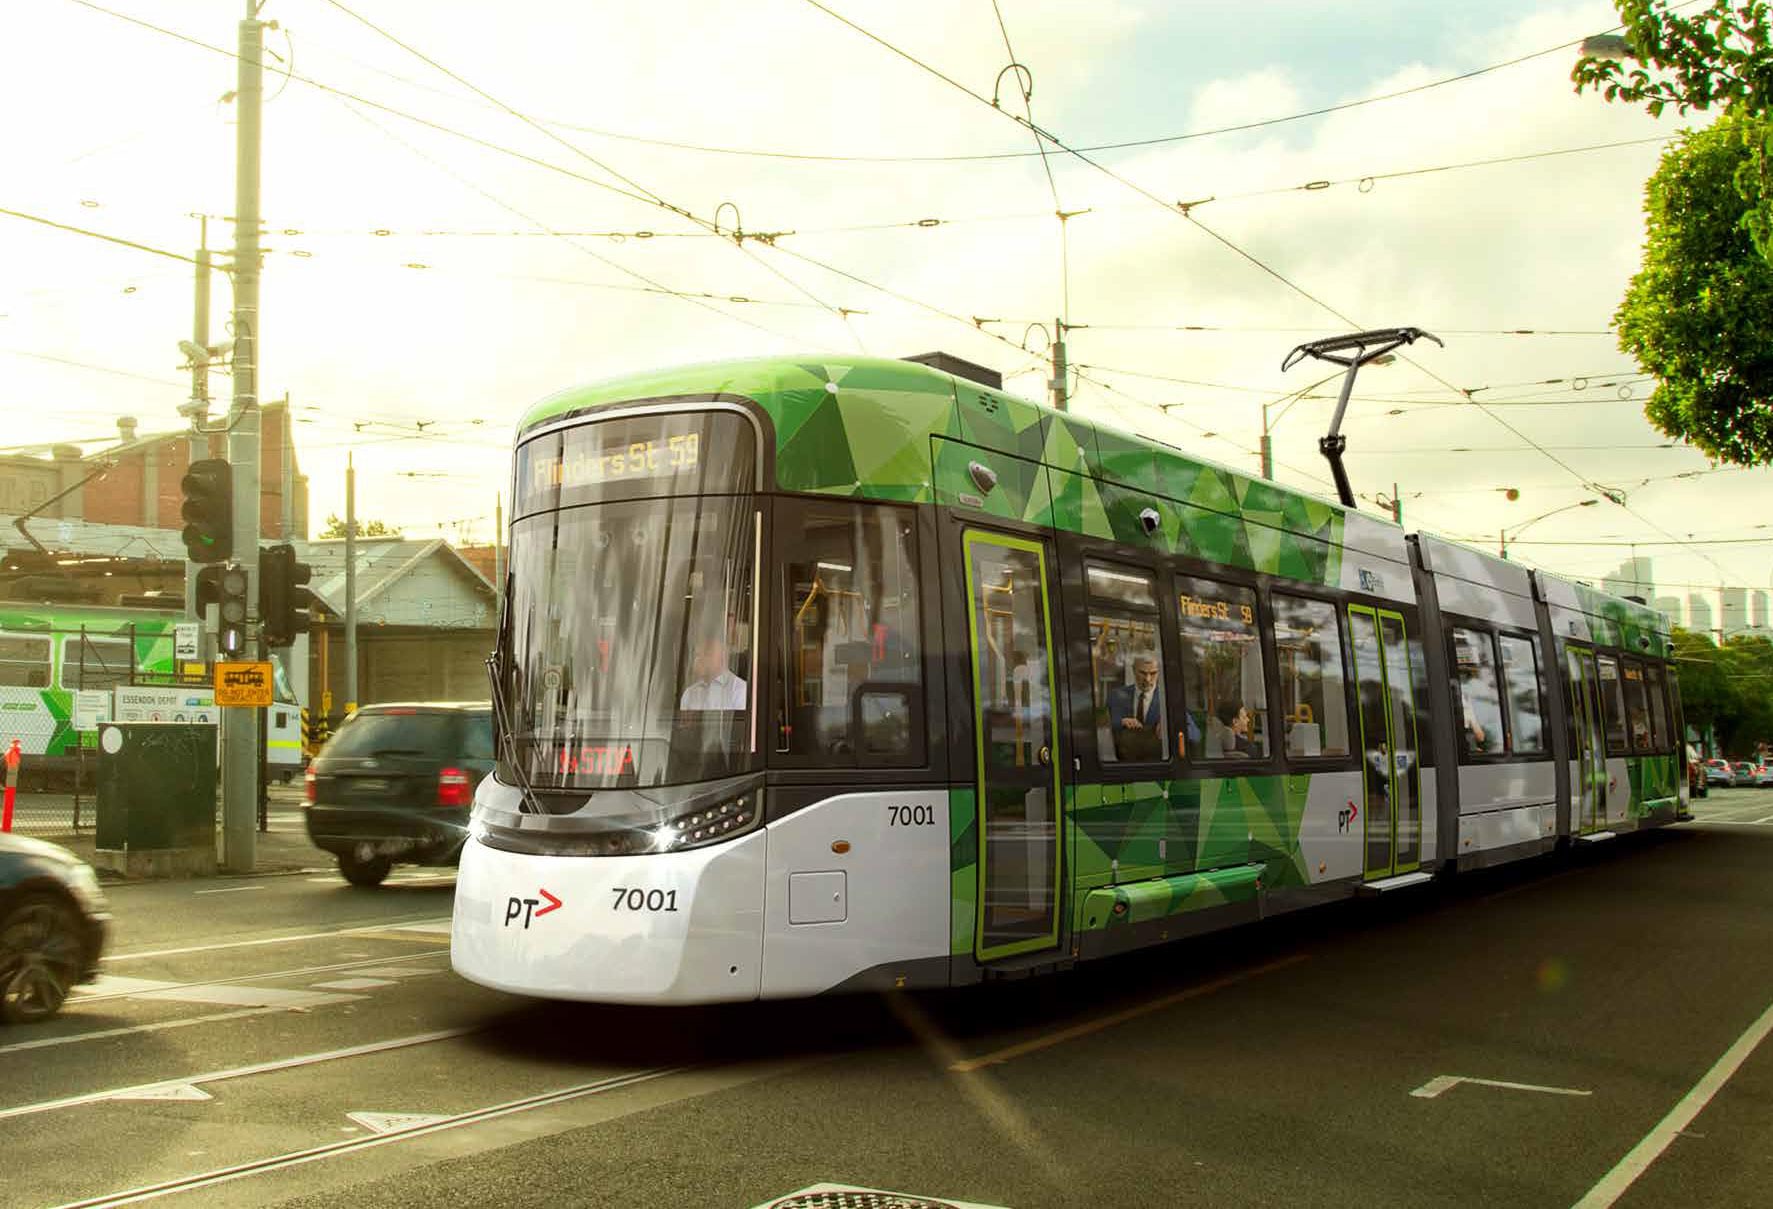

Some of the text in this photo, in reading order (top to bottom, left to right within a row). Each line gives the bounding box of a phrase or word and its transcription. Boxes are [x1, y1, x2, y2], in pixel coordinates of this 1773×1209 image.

[629, 442, 657, 473] St
[669, 433, 699, 466] 59
[1180, 594, 1253, 625] Flinders St 59
[581, 746, 633, 775] STOP
[887, 804, 936, 827] 7001
[1338, 809, 1351, 834] PT
[505, 896, 540, 930] PT
[611, 887, 679, 912] 7001
